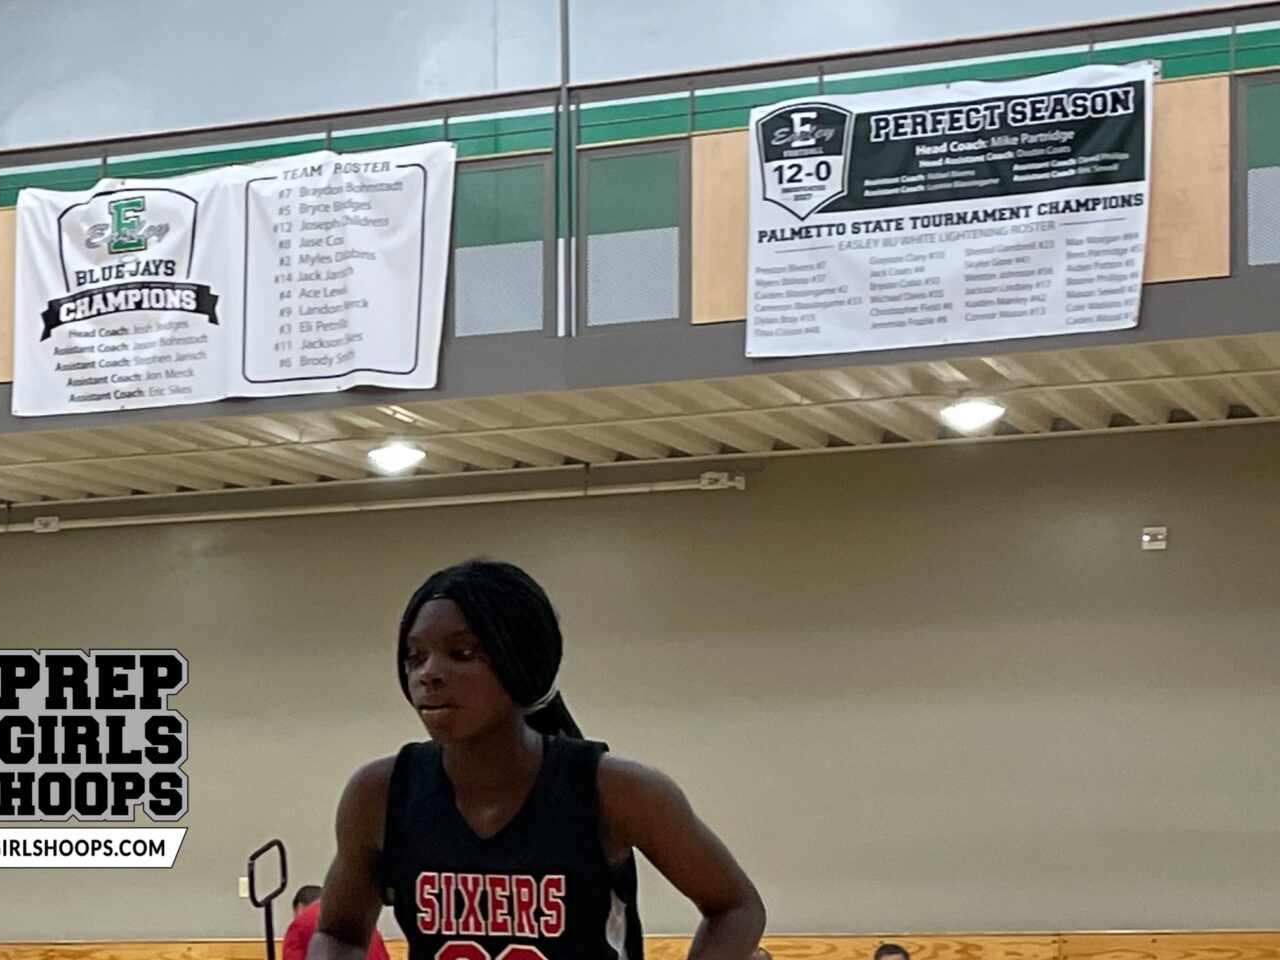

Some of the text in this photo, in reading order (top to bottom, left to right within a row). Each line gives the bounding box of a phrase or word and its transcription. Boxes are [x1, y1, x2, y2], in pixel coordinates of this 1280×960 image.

[871, 87, 1135, 142] PERFECT SEASON
[791, 112, 817, 147] E
[916, 141, 947, 156] Head
[950, 138, 988, 153] Coach:
[283, 165, 322, 180] TEAM
[773, 161, 831, 185] 12-0
[108, 196, 147, 254] E
[758, 193, 1144, 243] PALMETTO STATE TOURNAMENT CHAMPIONS
[838, 239, 880, 251] EASLEY
[900, 234, 936, 246] WHITE
[938, 223, 1008, 242] LIGHTENING
[1011, 220, 1055, 234] ROSTER
[75, 260, 176, 286] BLUE JAYS
[59, 288, 197, 323] CHAMPIONS
[69, 328, 95, 338] Head
[98, 327, 129, 337] Coach:
[97, 343, 129, 352] Coach:
[99, 359, 130, 368] Coach:
[111, 374, 142, 383] Coach:
[114, 391, 145, 400] Coach:
[415, 871, 566, 938] SIXERS
